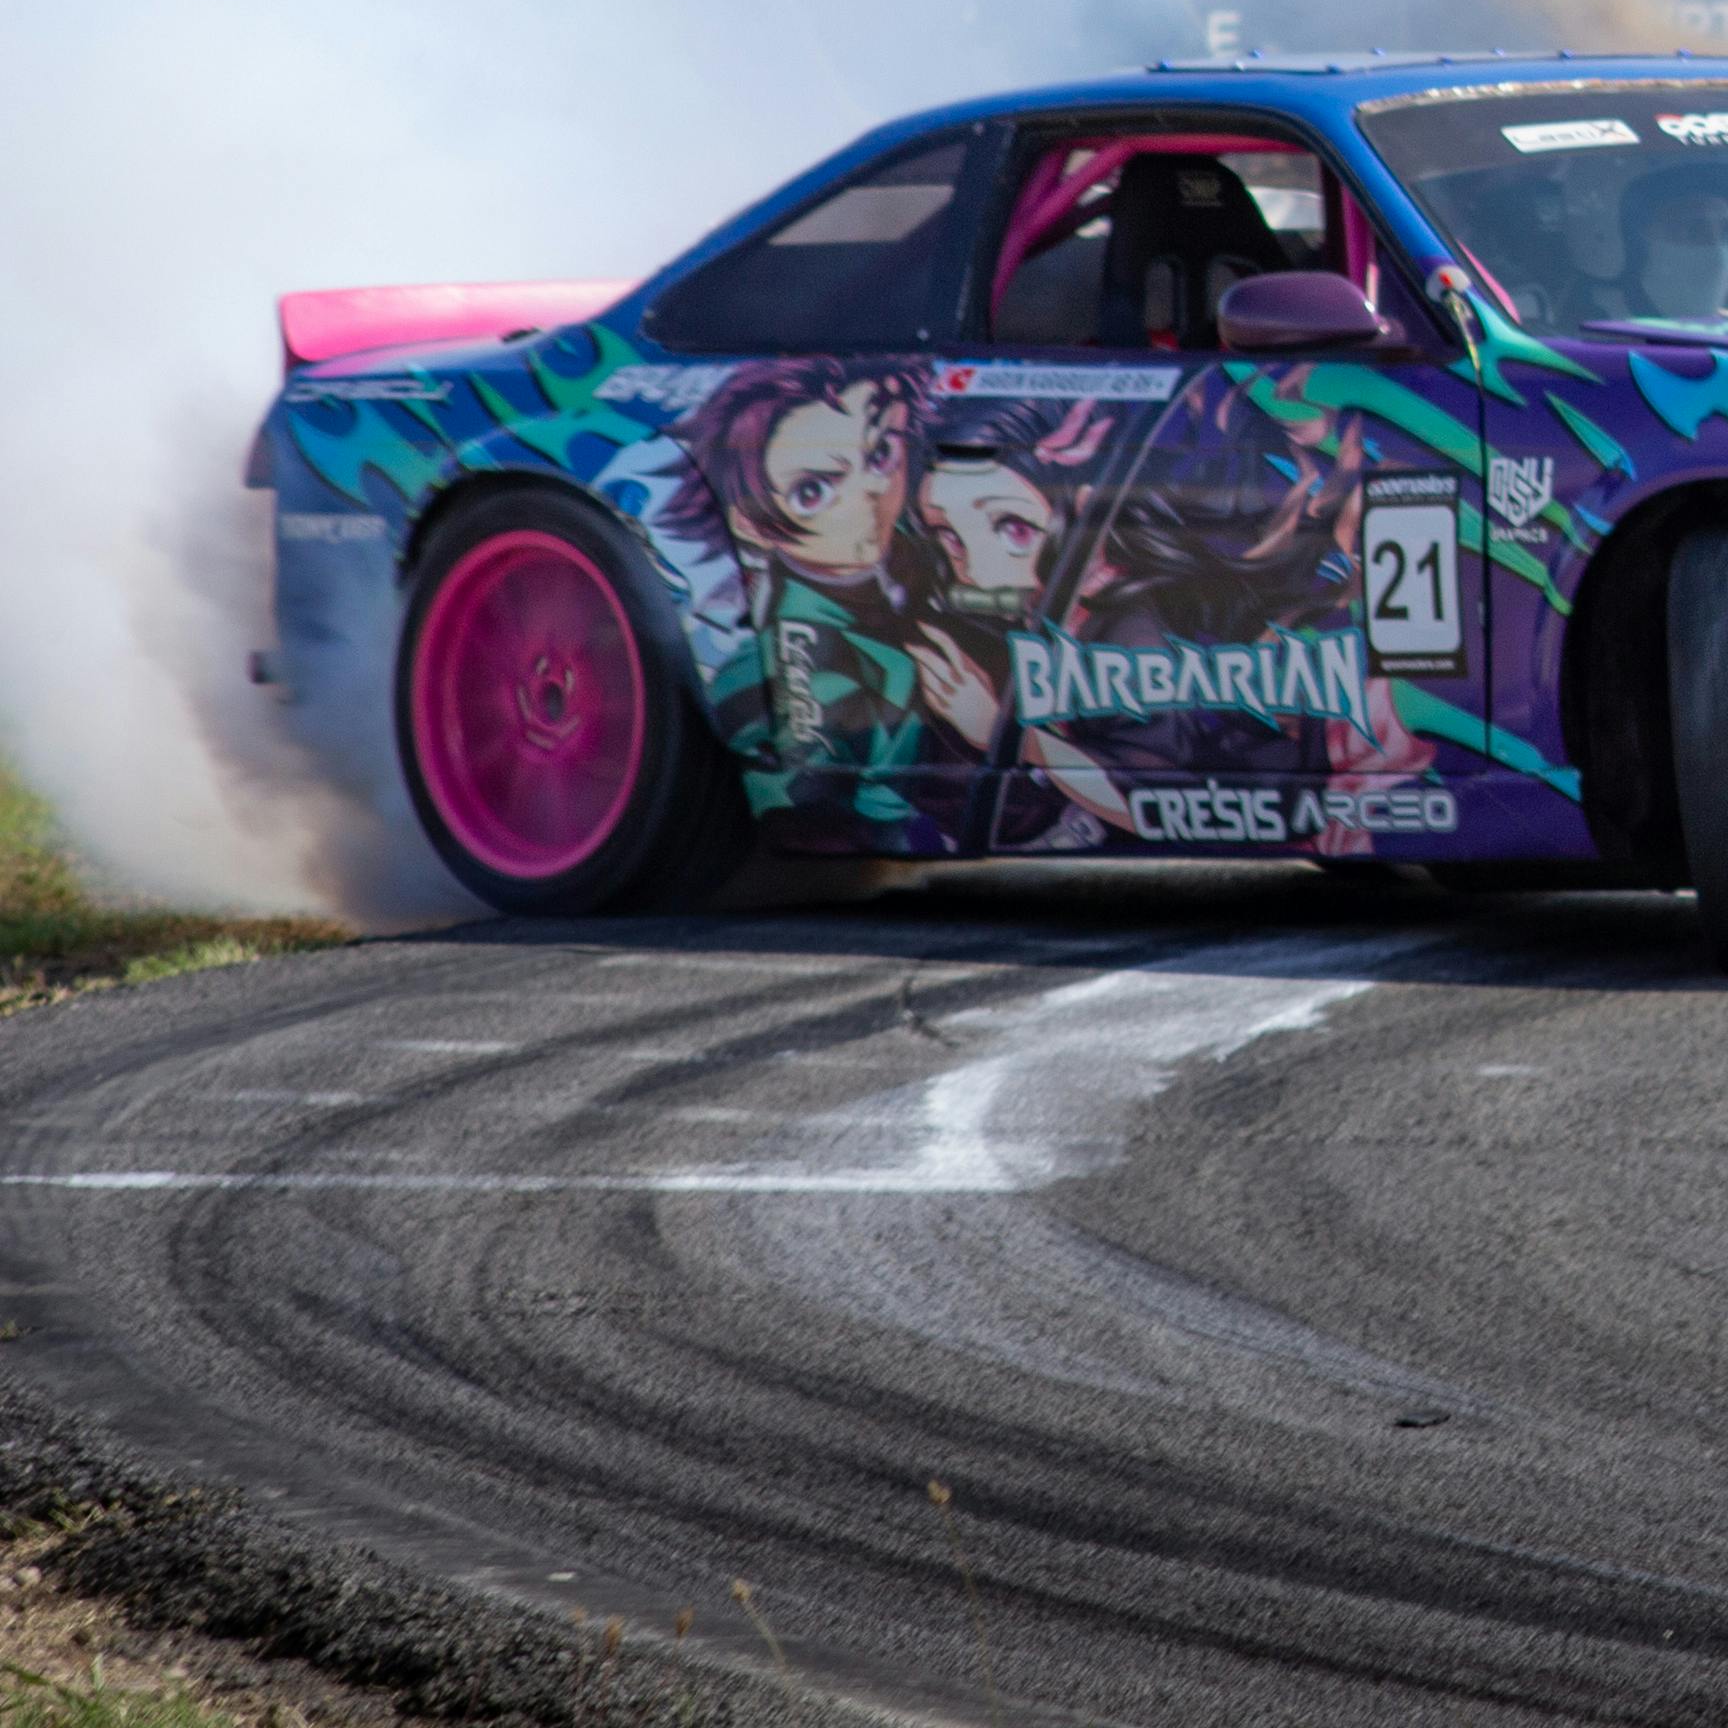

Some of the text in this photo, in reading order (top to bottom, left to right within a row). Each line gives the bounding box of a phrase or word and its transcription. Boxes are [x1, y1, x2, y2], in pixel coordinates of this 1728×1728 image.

[1372, 539, 1444, 621] 21
[1006, 617, 1388, 756] BARBARIAN
[1290, 790, 1458, 834] ARCEO
